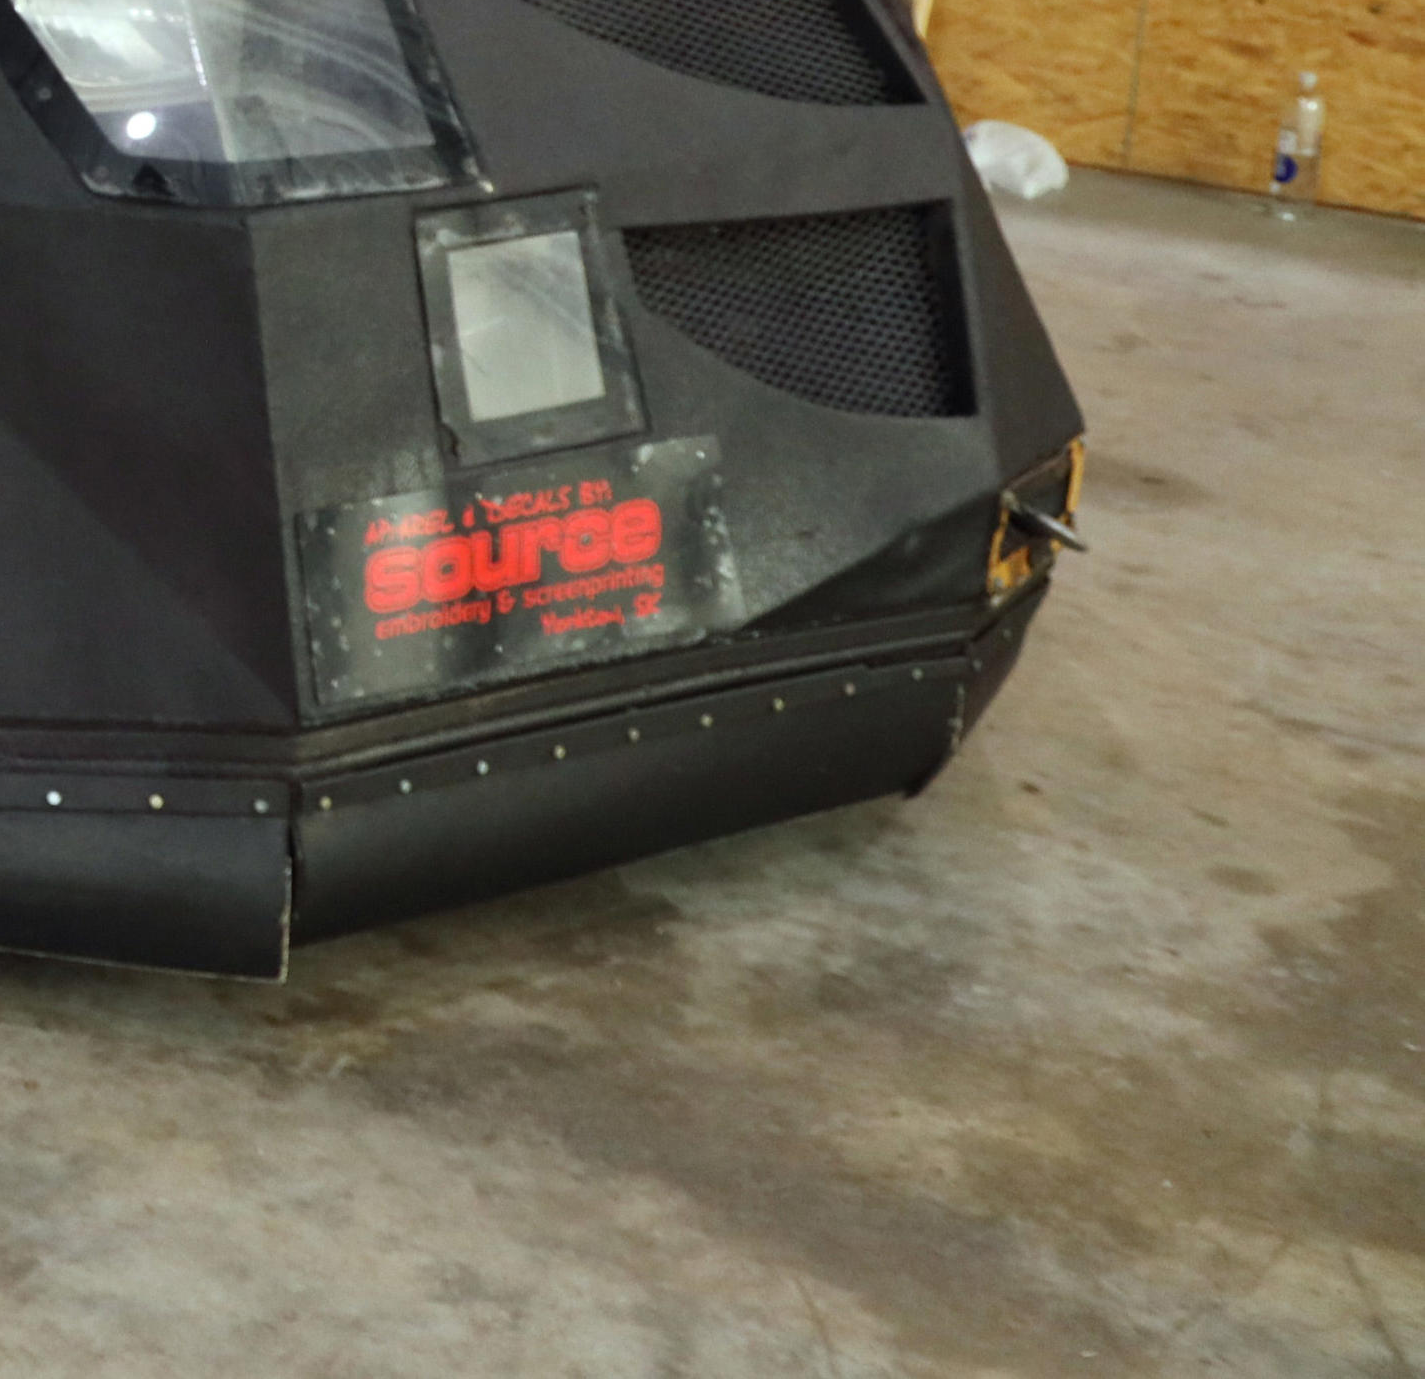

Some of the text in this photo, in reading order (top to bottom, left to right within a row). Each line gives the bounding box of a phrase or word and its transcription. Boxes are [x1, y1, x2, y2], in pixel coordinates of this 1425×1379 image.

[363, 497, 663, 614] source
[374, 563, 665, 640] embroidery & screenprinting
